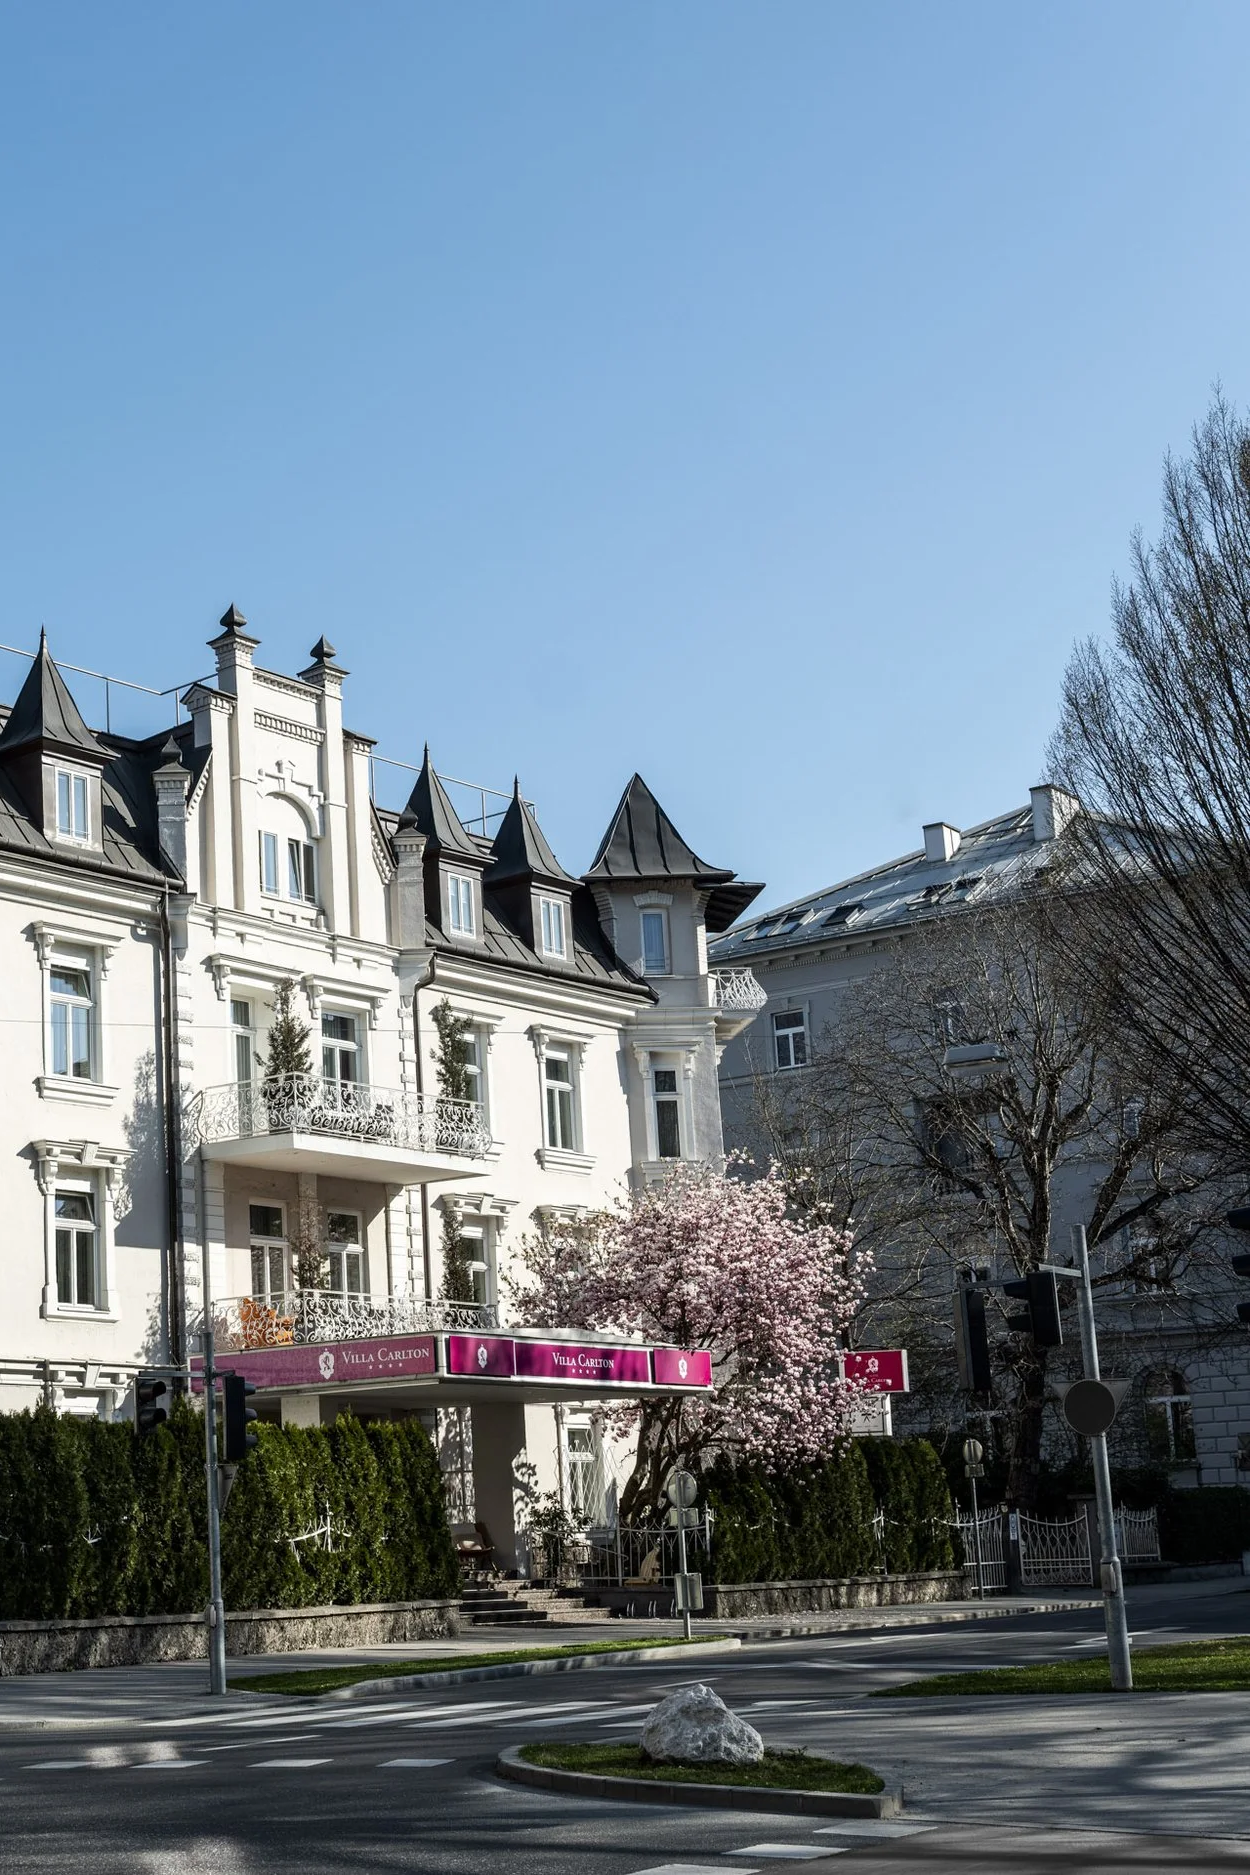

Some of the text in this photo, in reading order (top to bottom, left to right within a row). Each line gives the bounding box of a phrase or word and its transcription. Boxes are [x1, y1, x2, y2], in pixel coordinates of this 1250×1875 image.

[342, 1348, 429, 1364] VILLA CARLTON
[552, 1352, 614, 1368] VILLA CARLTON
